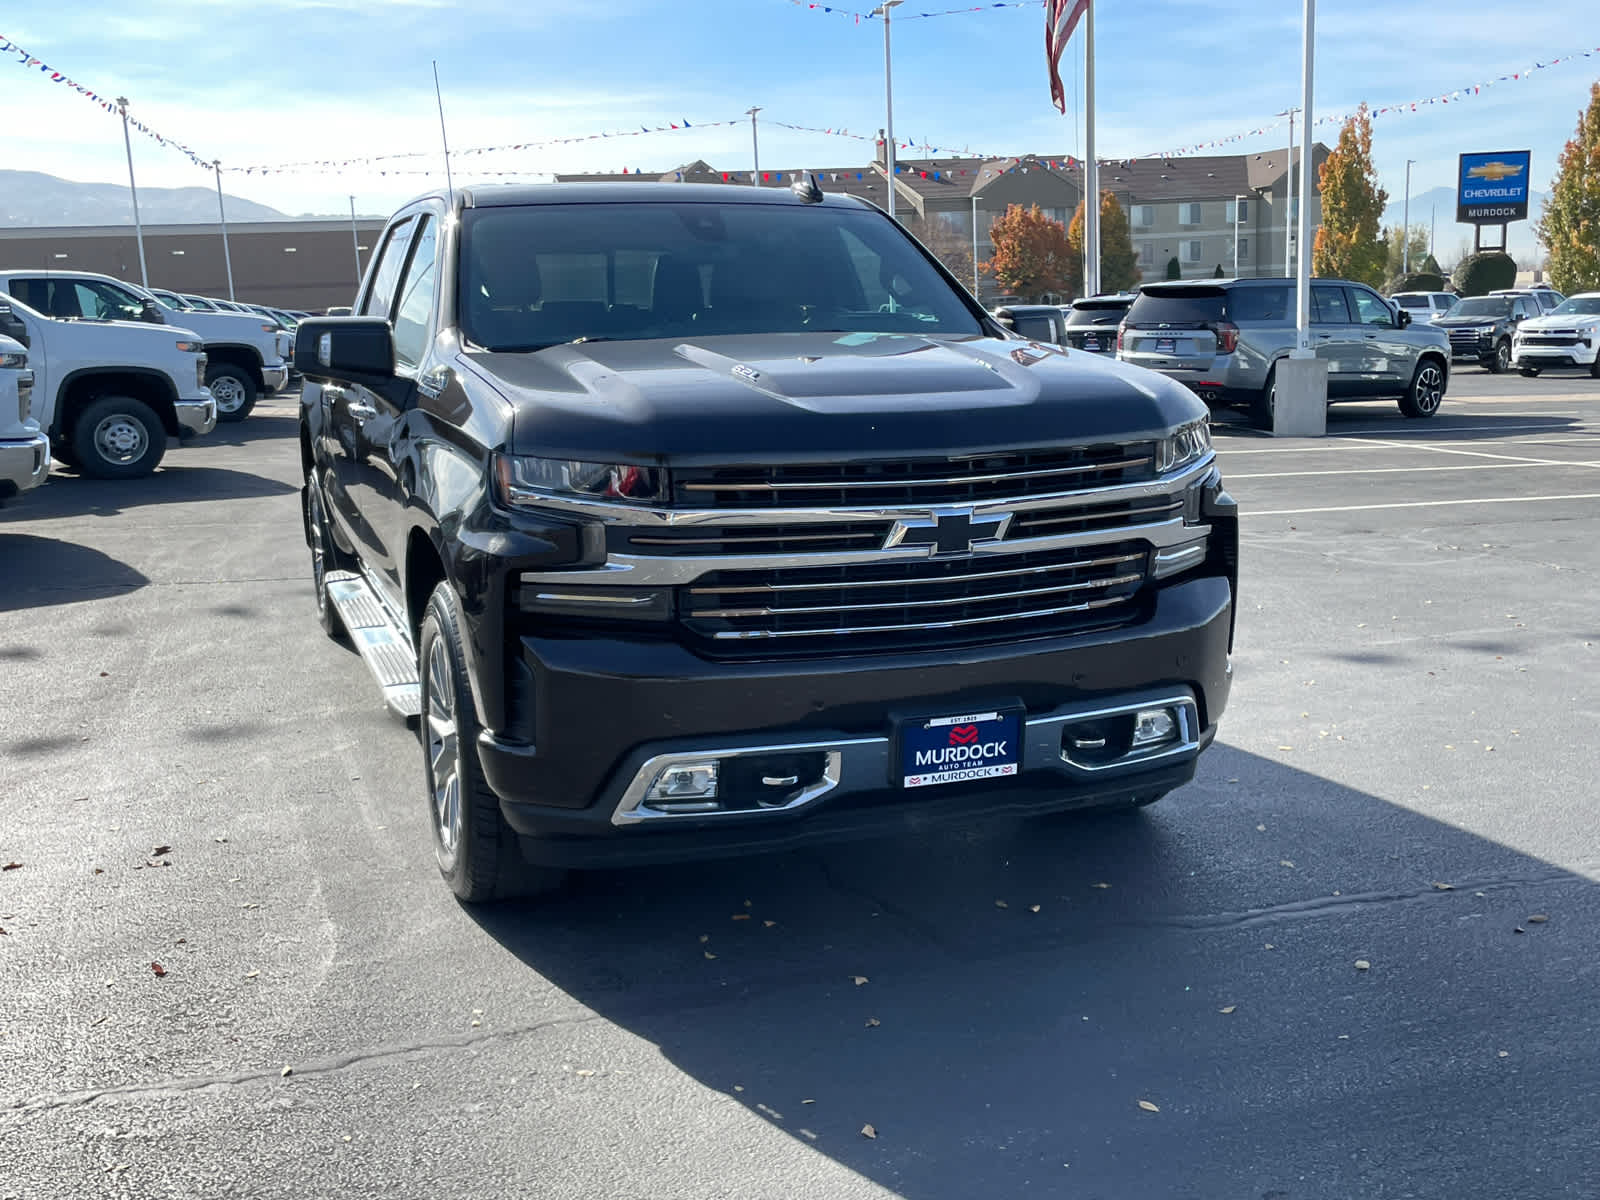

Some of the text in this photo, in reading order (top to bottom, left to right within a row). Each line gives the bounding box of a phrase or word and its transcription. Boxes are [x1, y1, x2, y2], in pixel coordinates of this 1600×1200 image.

[1464, 187, 1522, 198] CHEVROLET
[1468, 208, 1517, 217] MURDOCK
[915, 741, 1008, 766] MURDOCK
[962, 760, 984, 768] TEAM
[931, 767, 992, 783] MURDOCK
